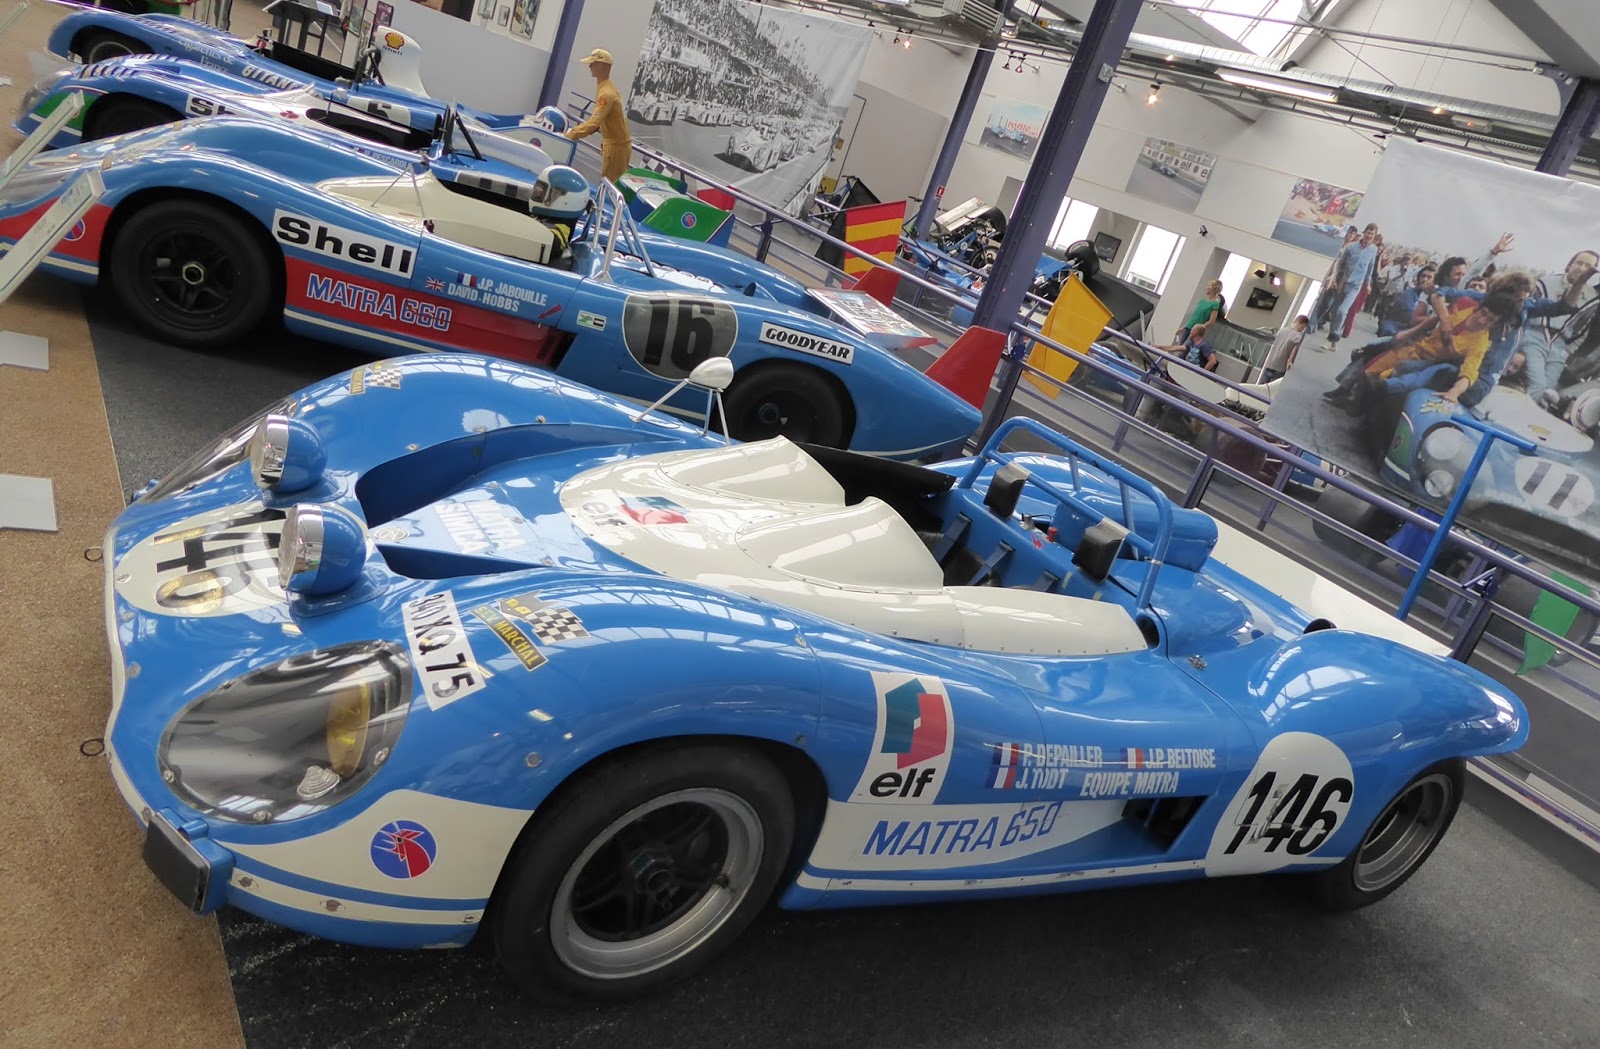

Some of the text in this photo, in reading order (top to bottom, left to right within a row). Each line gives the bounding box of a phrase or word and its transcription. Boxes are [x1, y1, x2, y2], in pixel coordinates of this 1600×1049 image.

[1180, 160, 1192, 172] elf
[276, 215, 411, 275] Shell
[306, 273, 452, 332] MATRA 660
[447, 282, 479, 301] DAVID
[495, 281, 548, 307] JABOUILLE
[643, 298, 716, 373] 16
[764, 326, 851, 360] GOODYEAR
[1522, 461, 1580, 511] 11
[408, 593, 476, 699] 340 XQ 75
[494, 619, 541, 667] MARCHAL
[1036, 743, 1103, 768] DEPAILLER
[1168, 748, 1216, 769] BELTOISE
[868, 767, 936, 799] elf
[1080, 771, 1131, 799] EQUIPE
[1132, 771, 1180, 794] MATRA
[862, 800, 1065, 856] MATRA 650
[1223, 771, 1353, 856] 146
